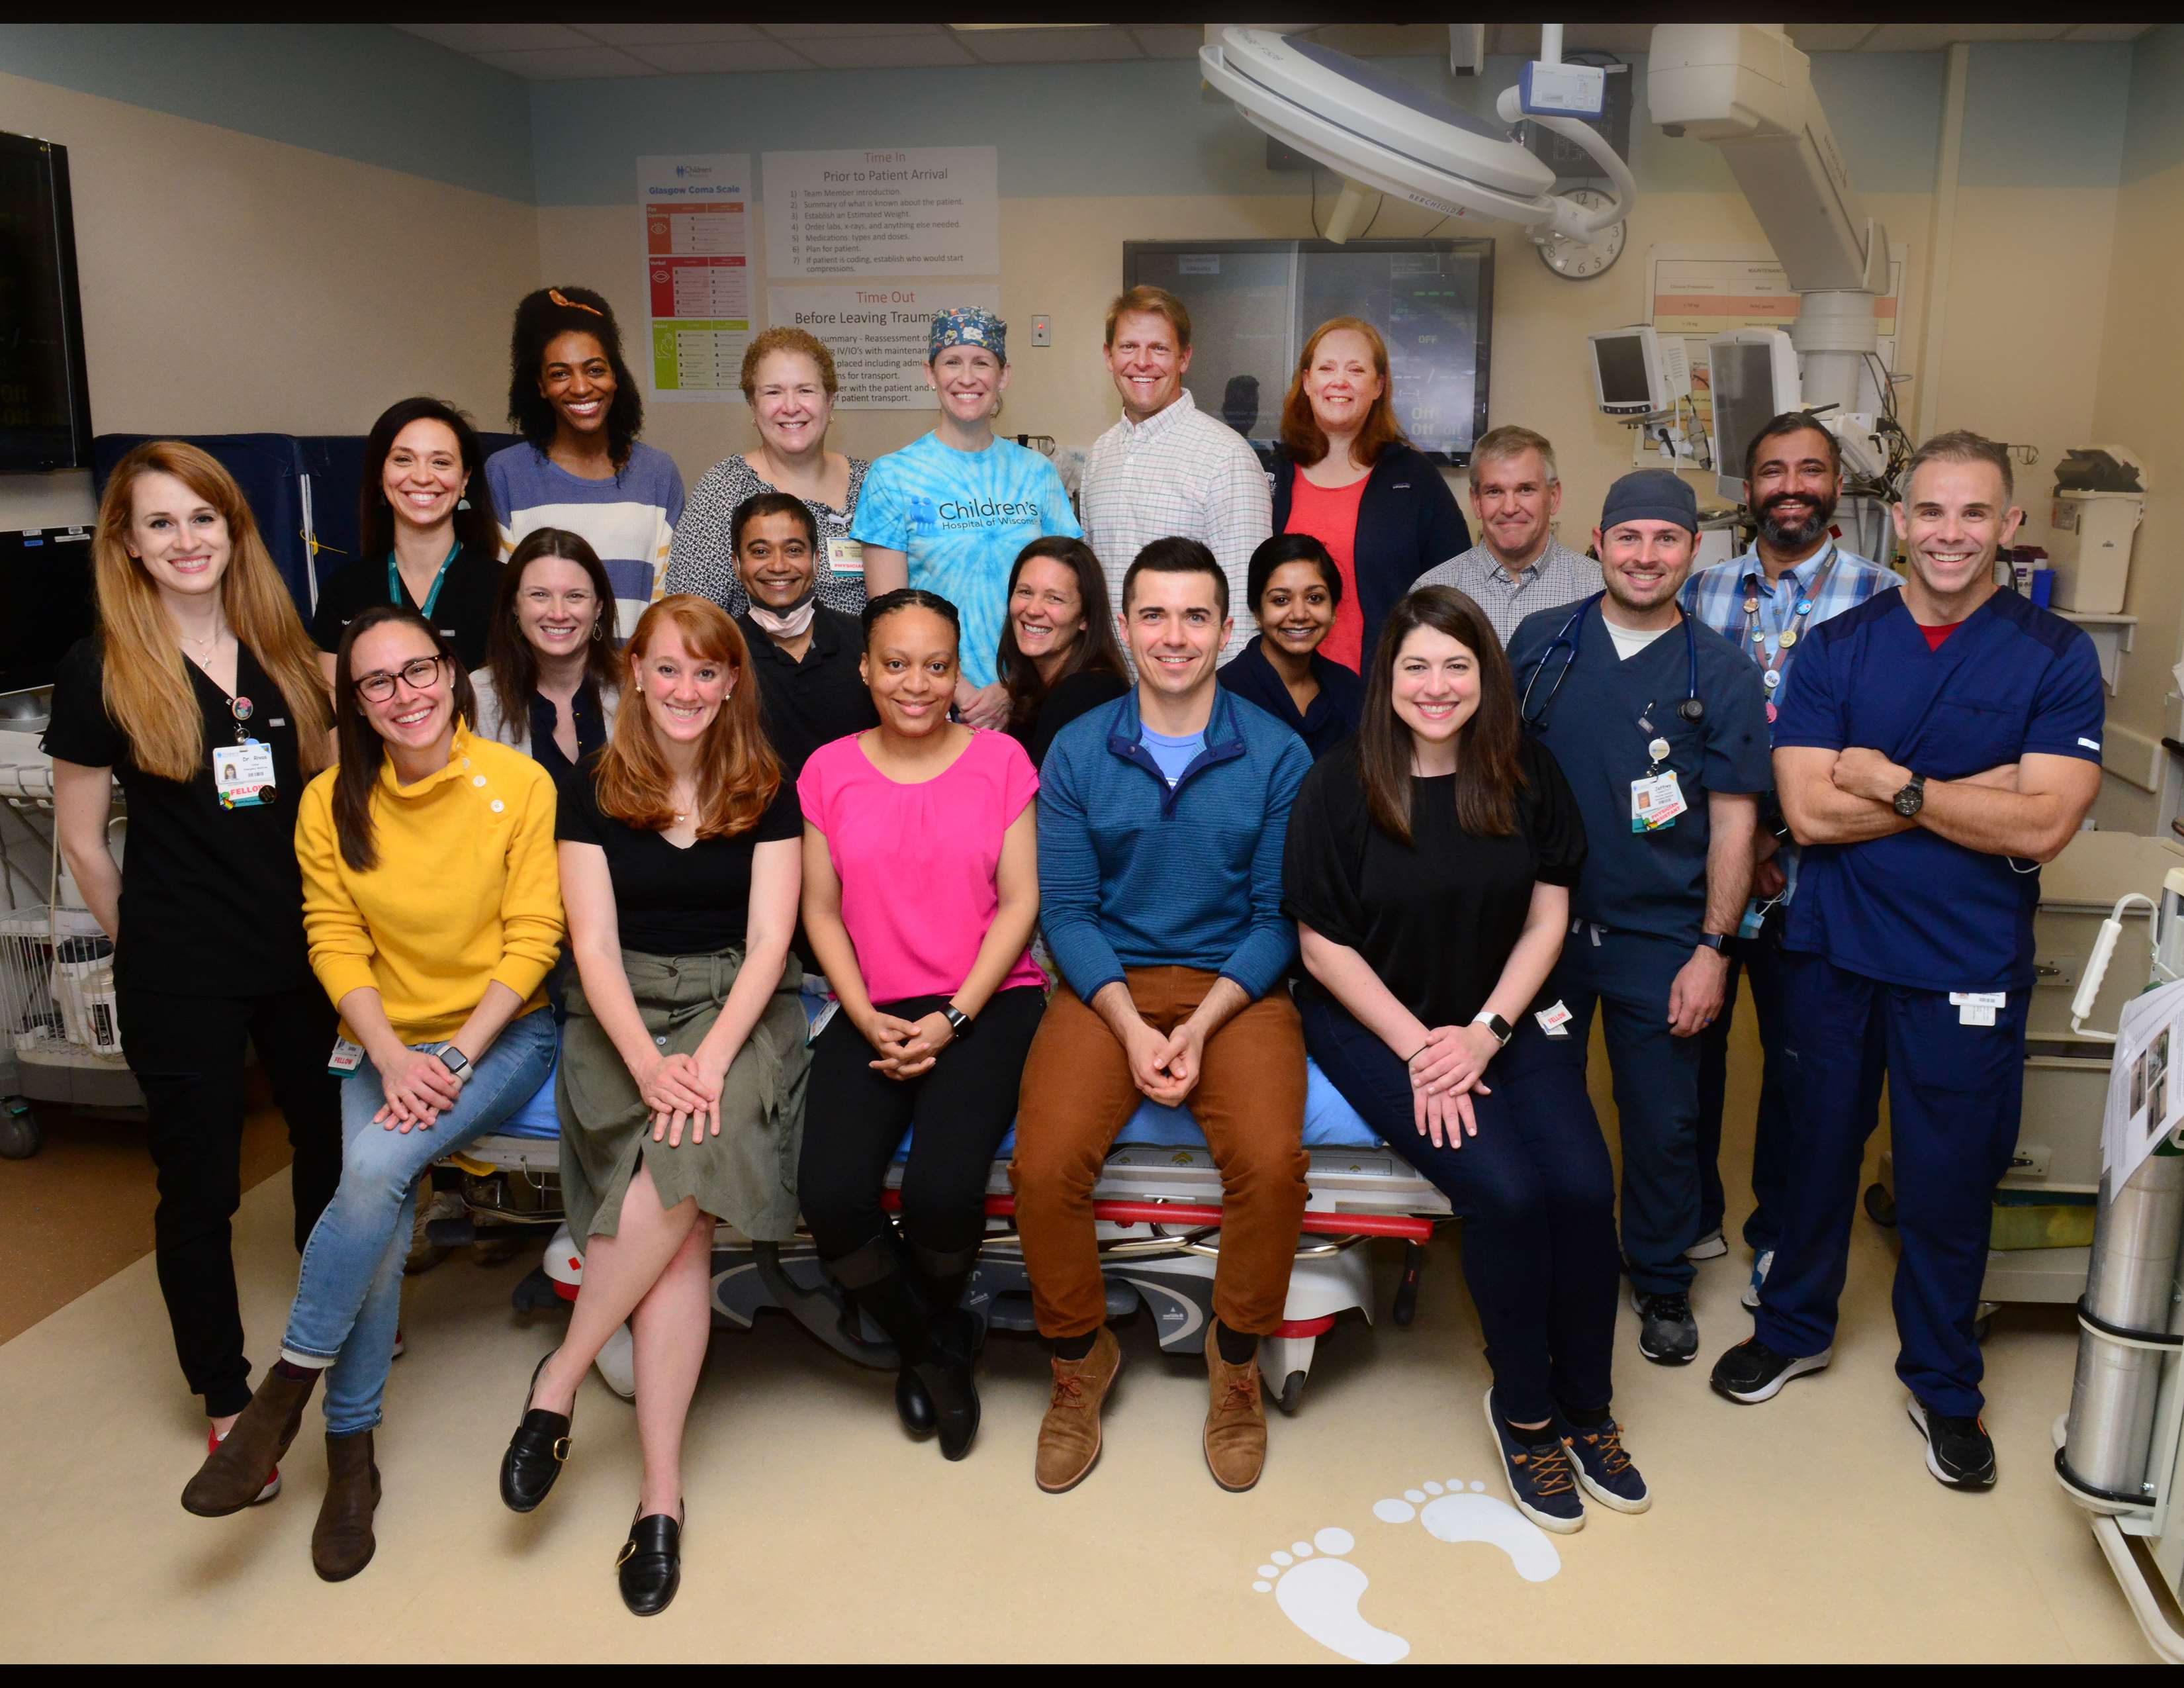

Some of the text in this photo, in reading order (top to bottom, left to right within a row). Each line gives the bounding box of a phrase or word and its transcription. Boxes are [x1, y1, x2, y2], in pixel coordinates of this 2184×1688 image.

[864, 152, 905, 163] Time In
[823, 168, 948, 181] Prior to Patient Arrival
[649, 187, 686, 195] Glasgow
[1575, 193, 1588, 205] 12
[1612, 226, 1619, 238] 3
[1606, 244, 1614, 254] 4
[846, 256, 872, 264] coding,
[1562, 259, 1569, 271] 7
[1594, 257, 1602, 269] 5
[1578, 261, 1586, 274] 6
[856, 291, 915, 303] Time Out
[795, 311, 935, 326] Before Leaving Trauma
[864, 334, 921, 343] Reassessment
[837, 359, 863, 368] placed
[864, 359, 901, 369] including
[848, 371, 859, 380] for
[861, 372, 900, 381] transport.
[884, 384, 913, 393] patient
[841, 394, 870, 403] patient
[872, 394, 911, 403] transport.
[939, 497, 1038, 520] Children's
[942, 518, 983, 530] Hospital
[986, 517, 996, 526] of
[334, 1056, 353, 1065] FELLOW
